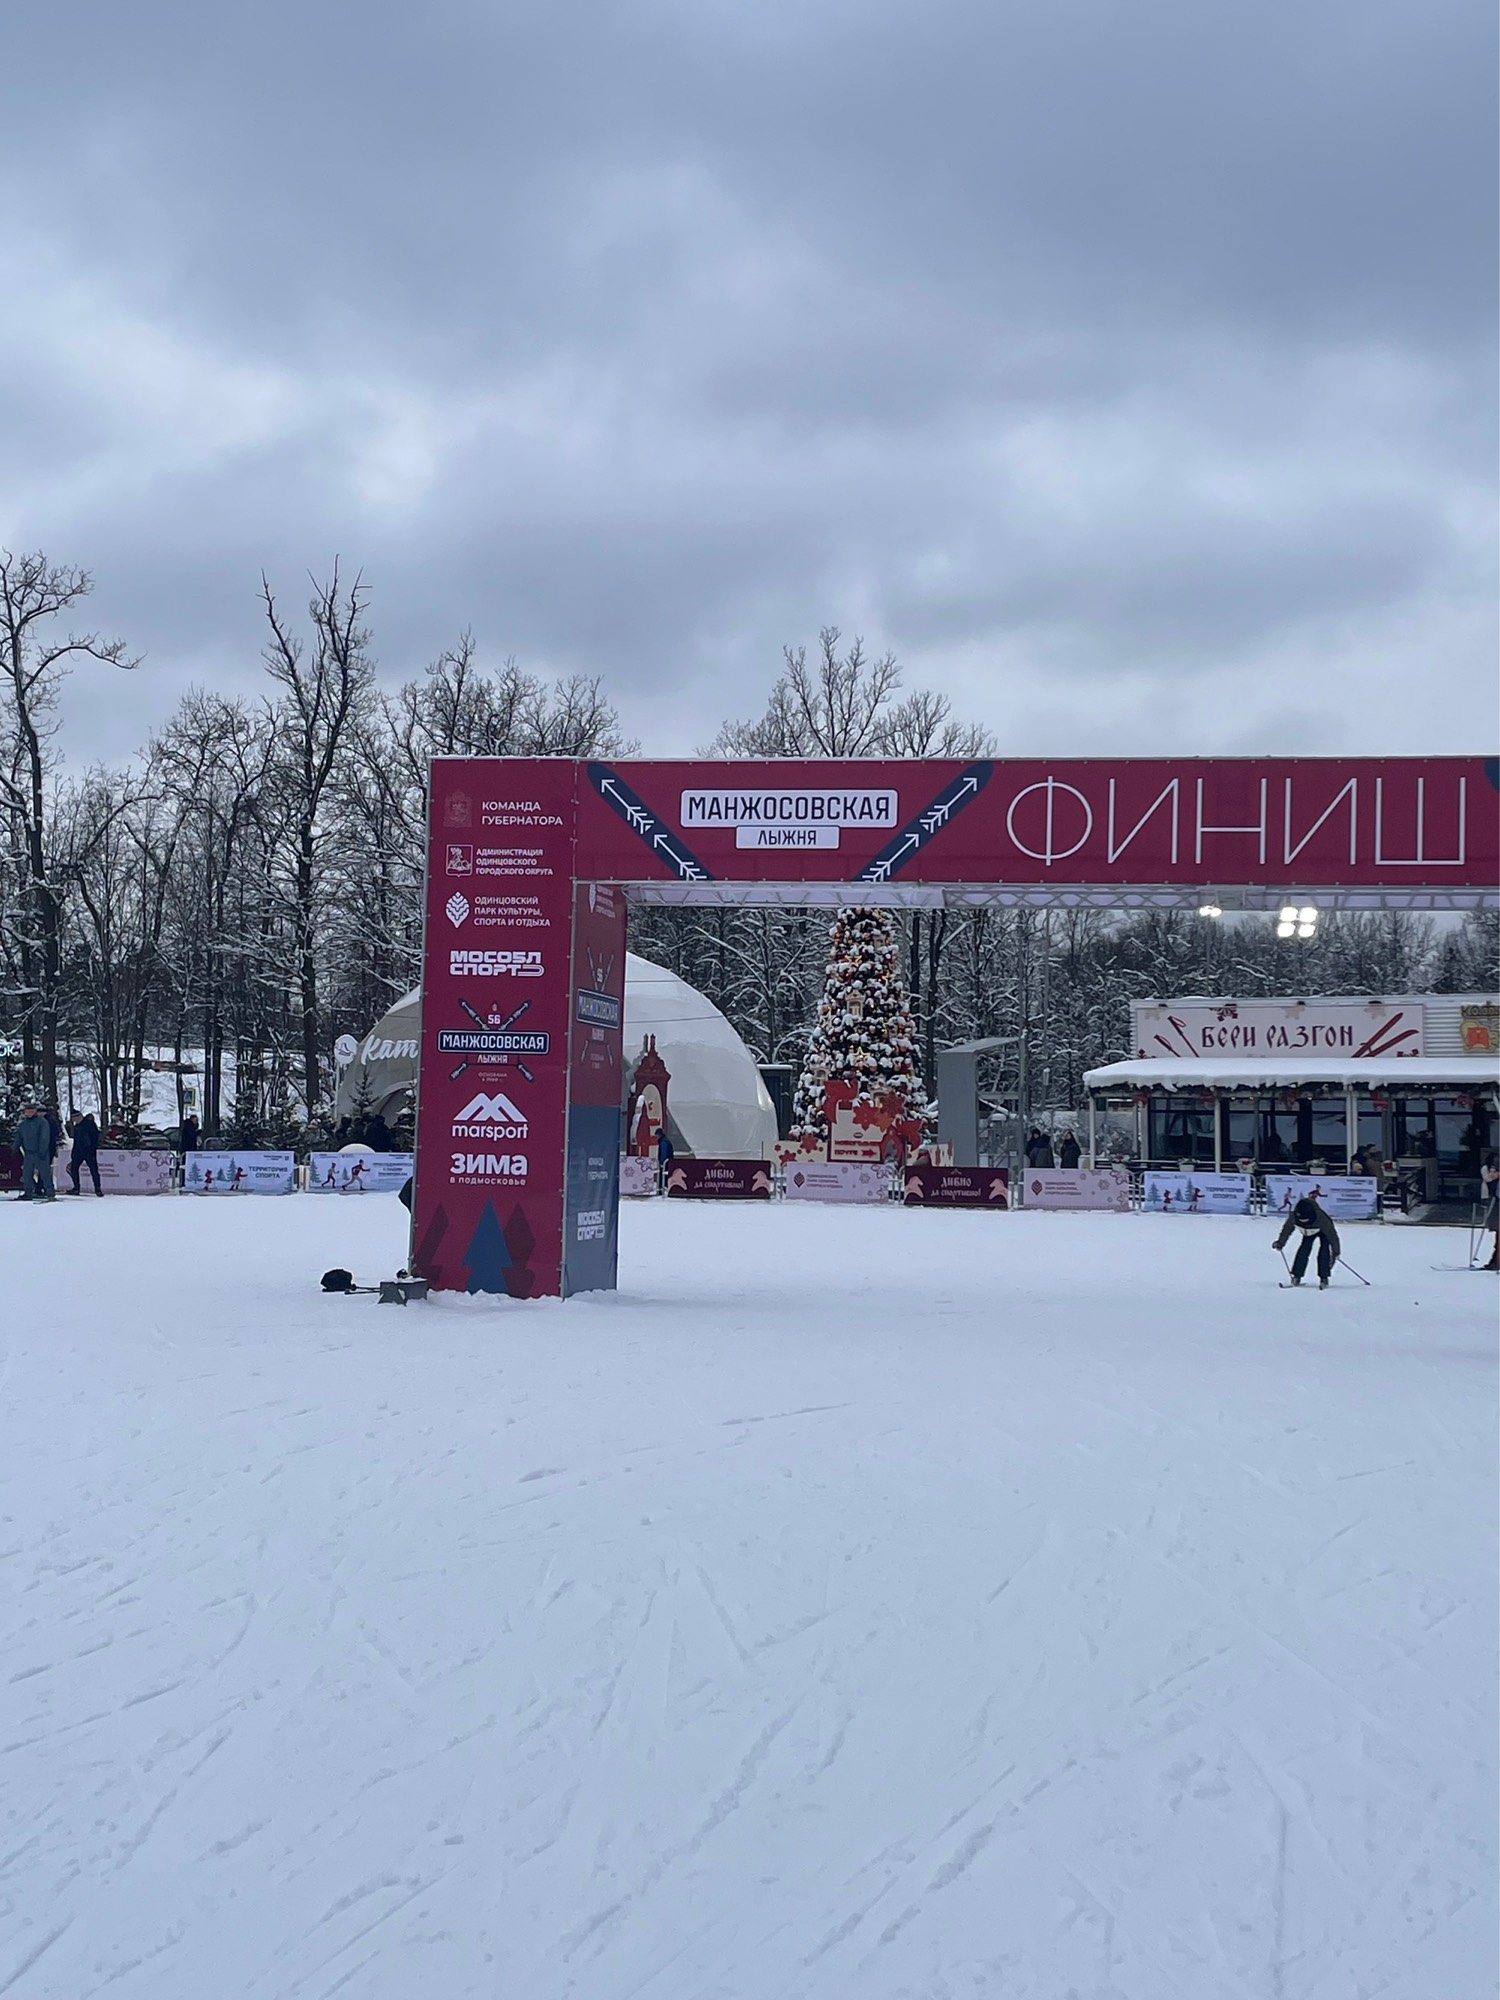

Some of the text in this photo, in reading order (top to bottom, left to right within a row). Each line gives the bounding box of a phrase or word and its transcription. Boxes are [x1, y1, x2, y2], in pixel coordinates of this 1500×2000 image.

[481, 800, 542, 812] КОМАНДА
[688, 795, 891, 821] МАНЖОСОВСКАЯ
[481, 814, 564, 826] ГУБЕРНАТОРА
[1006, 775, 1467, 867] ФИНИШ
[757, 829, 818, 846] ЛЫЖНЯ
[476, 848, 544, 857] АДМИНИСТРАЦИЯ
[476, 857, 538, 867] ОДИНЦОВСКОГО
[475, 867, 554, 876] ГОРОДСКОГО ОКРУГА
[474, 895, 539, 906] ОДИНЦОВСКИЙ
[474, 907, 543, 917] ПАРК КУЛЬТУРЫ,
[473, 917, 551, 928] СПОРТА И ОТДЫХА
[450, 950, 542, 963] МОСОБЛ
[487, 1014, 502, 1025] 56
[441, 1033, 545, 1051] МАНЖОСОВСКАЯ
[1201, 1024, 1354, 1049] БЕРИ РАЗГОН
[477, 1054, 509, 1065] ЛЫЖНЯ
[452, 1123, 529, 1142] marsport
